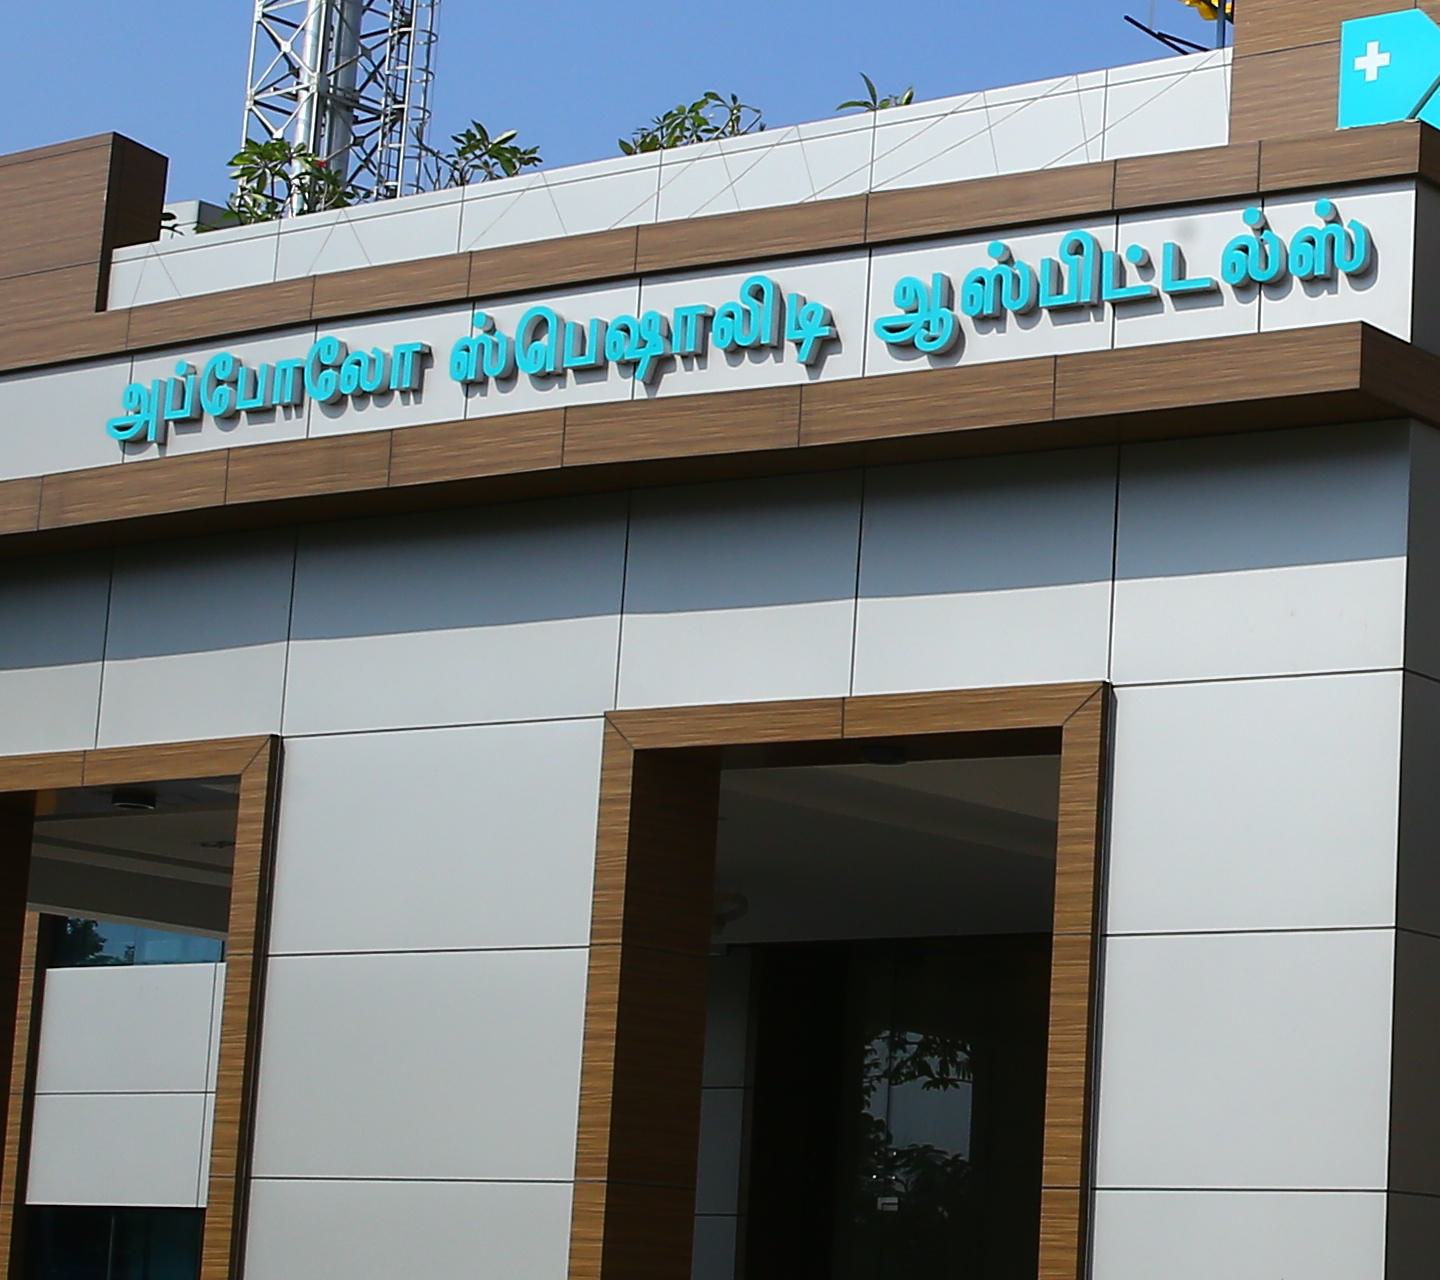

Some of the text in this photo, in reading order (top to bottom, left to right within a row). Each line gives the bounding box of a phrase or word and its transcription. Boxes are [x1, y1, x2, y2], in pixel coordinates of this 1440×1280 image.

[105, 197, 1370, 441] அப்போலோ ஸ்பெஷாலிடி ஆஸ்பிட்டல்ஸ்
